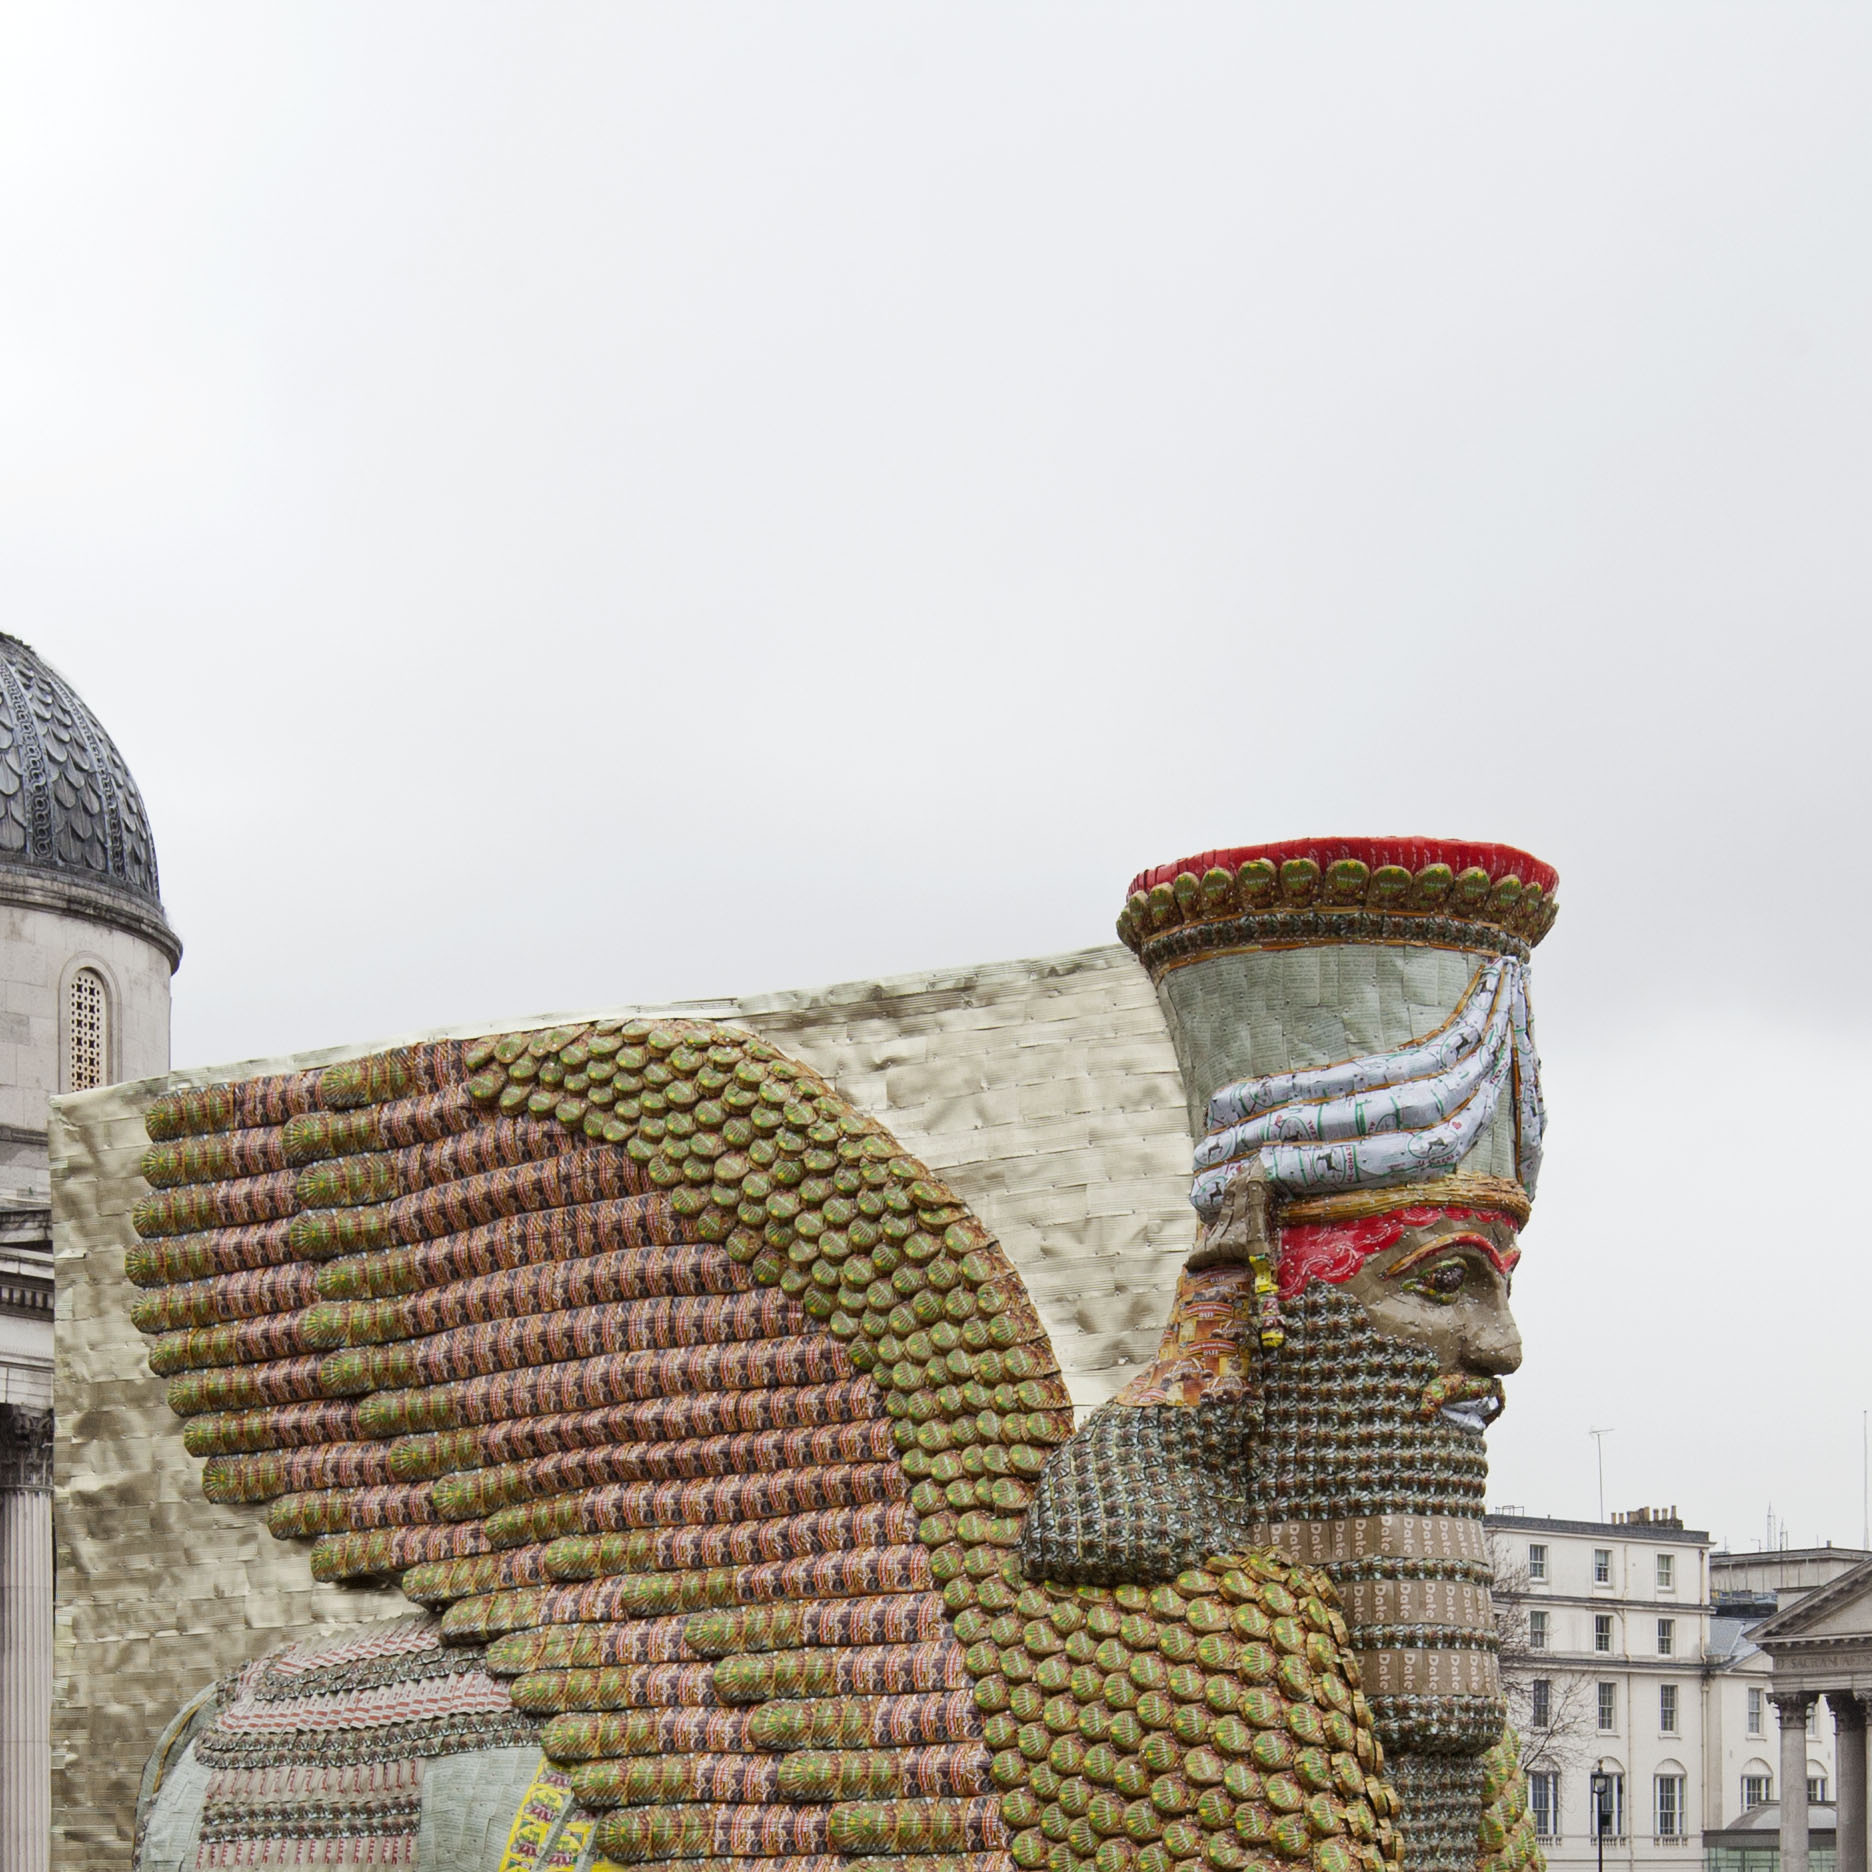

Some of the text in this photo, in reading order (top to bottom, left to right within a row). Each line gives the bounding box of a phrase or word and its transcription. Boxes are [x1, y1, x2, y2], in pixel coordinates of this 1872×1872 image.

[1289, 1524, 1300, 1560] Date
[1310, 1523, 1322, 1560] Date
[1334, 1521, 1346, 1558] Date
[1355, 1519, 1367, 1556] Date
[1380, 1517, 1393, 1552] Date
[1403, 1518, 1415, 1554] Date
[1422, 1518, 1434, 1555] Date
[1439, 1521, 1451, 1556] Date
[1455, 1521, 1467, 1556] Date
[1353, 1585, 1365, 1622] Date
[1374, 1584, 1386, 1621] Date
[1399, 1583, 1411, 1619] Date
[1425, 1583, 1436, 1619] Date
[1445, 1584, 1456, 1621] Date
[1463, 1587, 1473, 1622] Date
[1378, 1653, 1390, 1690] Date
[1404, 1653, 1416, 1691] Date
[1429, 1654, 1439, 1691] Date
[1450, 1654, 1461, 1691] Date
[1469, 1654, 1479, 1690] Date
